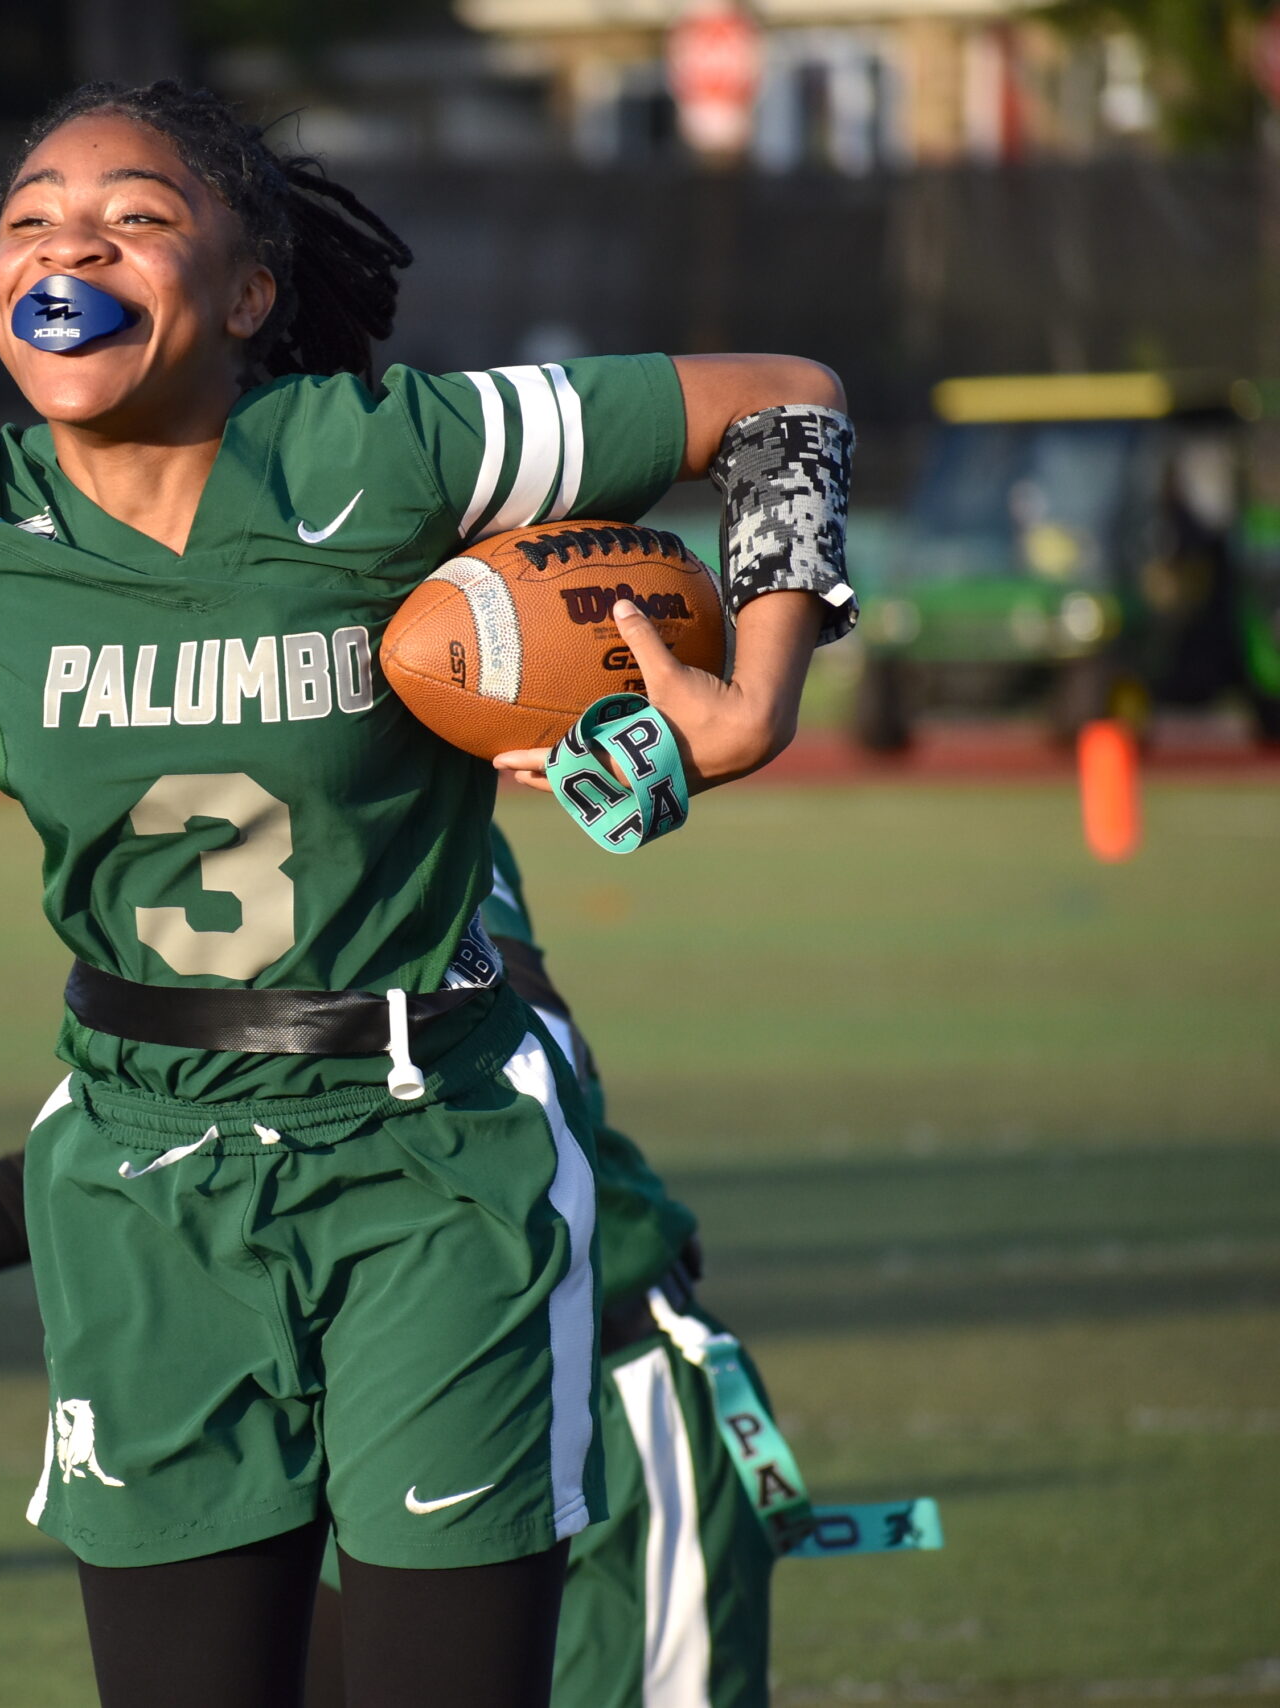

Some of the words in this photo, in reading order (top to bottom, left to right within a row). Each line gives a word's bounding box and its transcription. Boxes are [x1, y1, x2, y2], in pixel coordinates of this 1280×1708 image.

[33, 328, 81, 339] SHOCK
[43, 626, 374, 728] PALUMBO
[448, 641, 467, 689] GST
[129, 772, 296, 981] 3
